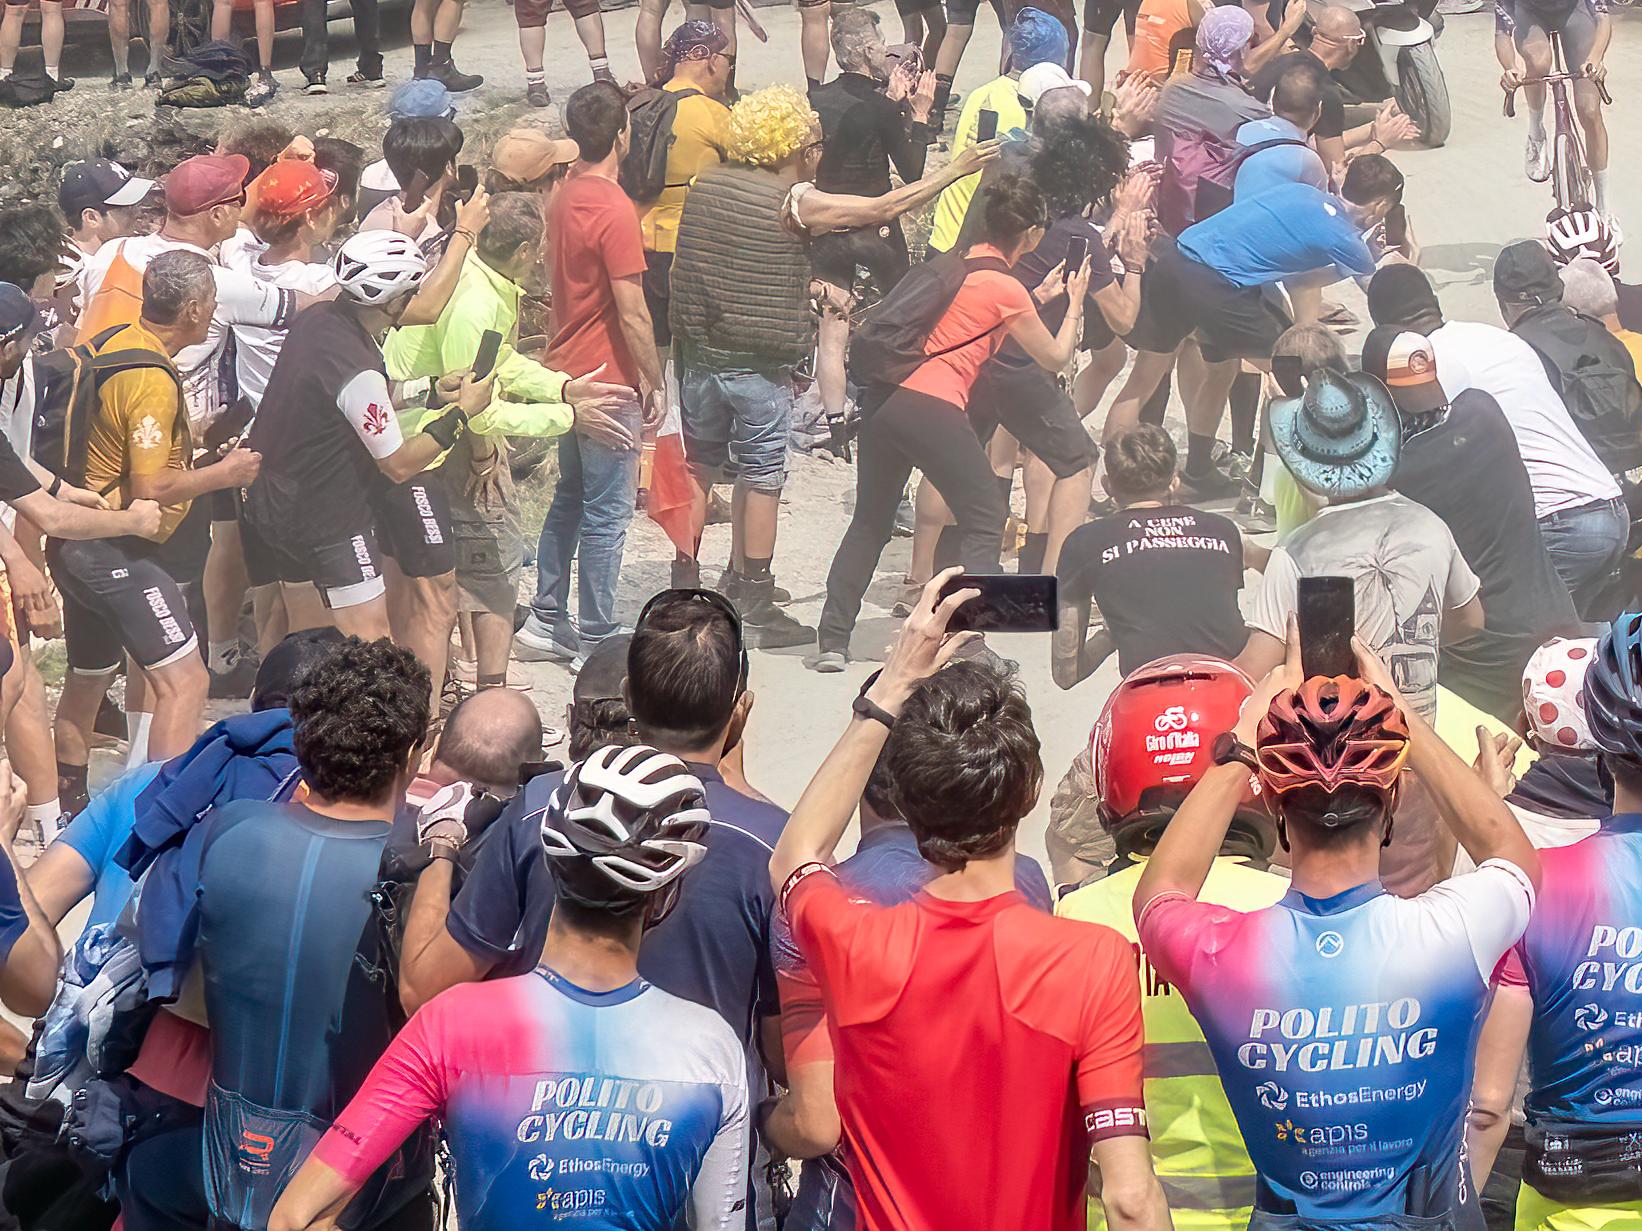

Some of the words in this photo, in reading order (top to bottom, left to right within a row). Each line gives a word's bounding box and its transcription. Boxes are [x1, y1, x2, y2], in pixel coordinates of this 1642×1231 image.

[1144, 526, 1184, 538] NON
[1102, 545, 1121, 564] SI
[1126, 536, 1230, 554] PASSEGGIA
[1249, 997, 1421, 1040] POLITO
[1237, 1027, 1438, 1072] CYCLING
[531, 1077, 664, 1113] POLITO
[1295, 1078, 1428, 1108] EthosEnergy
[516, 1109, 673, 1148] CYCLING
[1310, 1122, 1368, 1146] apis
[558, 1156, 650, 1178] EthosEnergy
